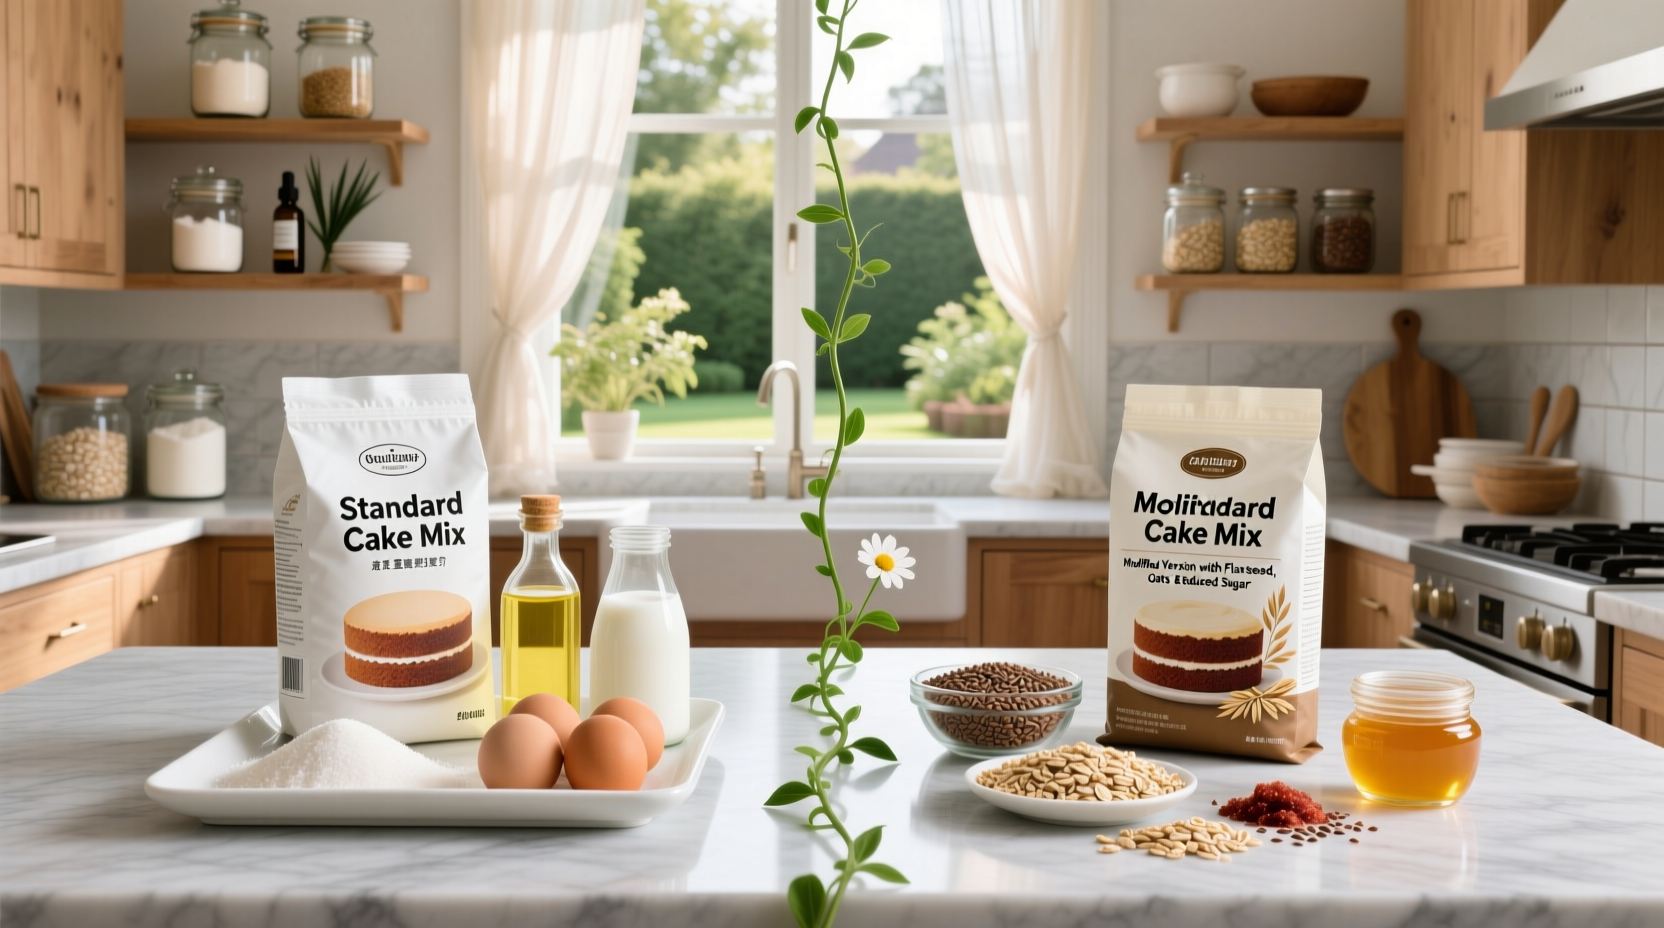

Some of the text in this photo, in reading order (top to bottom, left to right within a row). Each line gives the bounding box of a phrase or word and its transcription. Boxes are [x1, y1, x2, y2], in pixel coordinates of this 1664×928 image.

[340, 490, 463, 521] Standard
[343, 521, 466, 552] Cake Mix
[1144, 519, 1263, 547] Cake Mix
[1199, 561, 1222, 573] with
[1149, 573, 1170, 584] Oats
[1221, 577, 1252, 591] Sugar
